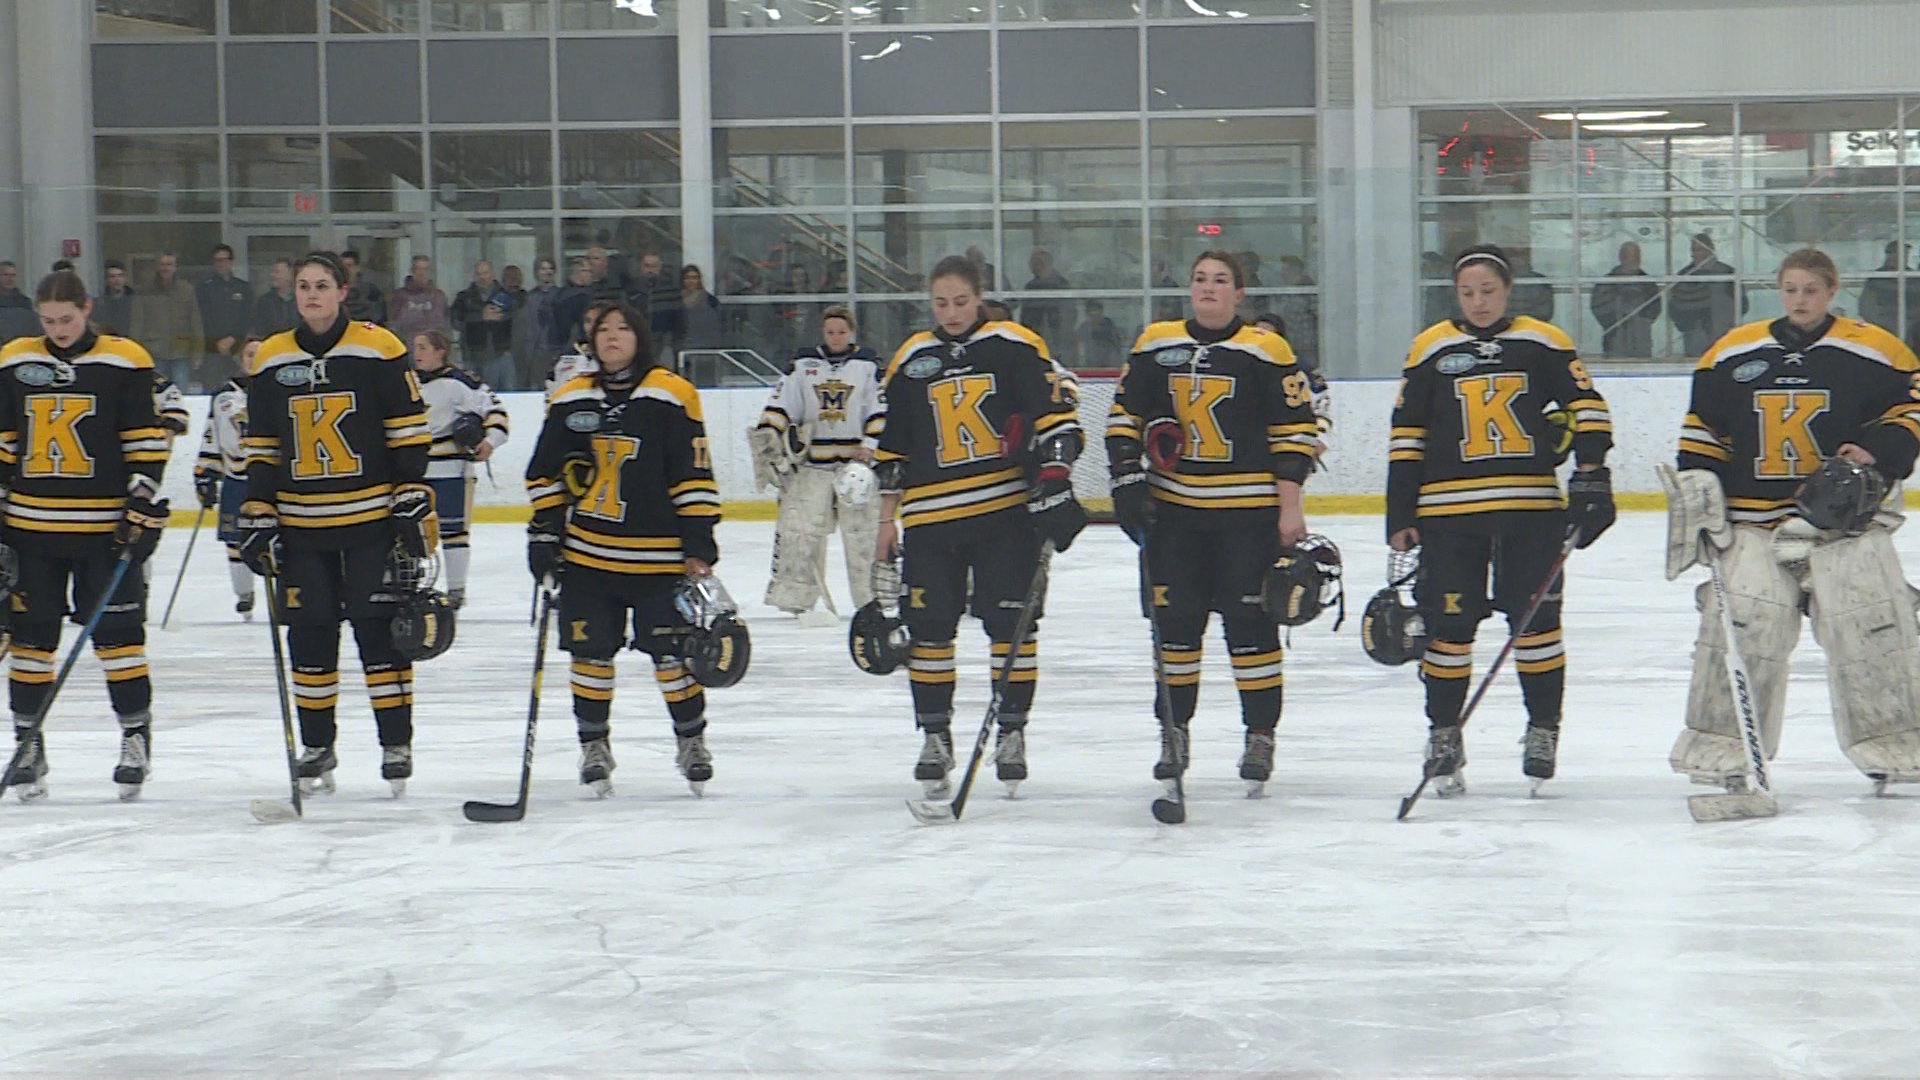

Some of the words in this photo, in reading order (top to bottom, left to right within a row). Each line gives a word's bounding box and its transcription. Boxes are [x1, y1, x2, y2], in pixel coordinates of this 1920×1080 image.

[22, 393, 97, 479] K
[288, 391, 363, 480] K
[821, 391, 845, 410] M
[927, 373, 1008, 469] K
[1168, 373, 1236, 462] K
[1454, 372, 1536, 462] K
[1753, 389, 1831, 479] K
[577, 434, 641, 523] K
[286, 585, 302, 608] K
[571, 620, 589, 642] K
[910, 587, 926, 608] K
[1152, 584, 1170, 607] K
[1444, 592, 1462, 614] K
